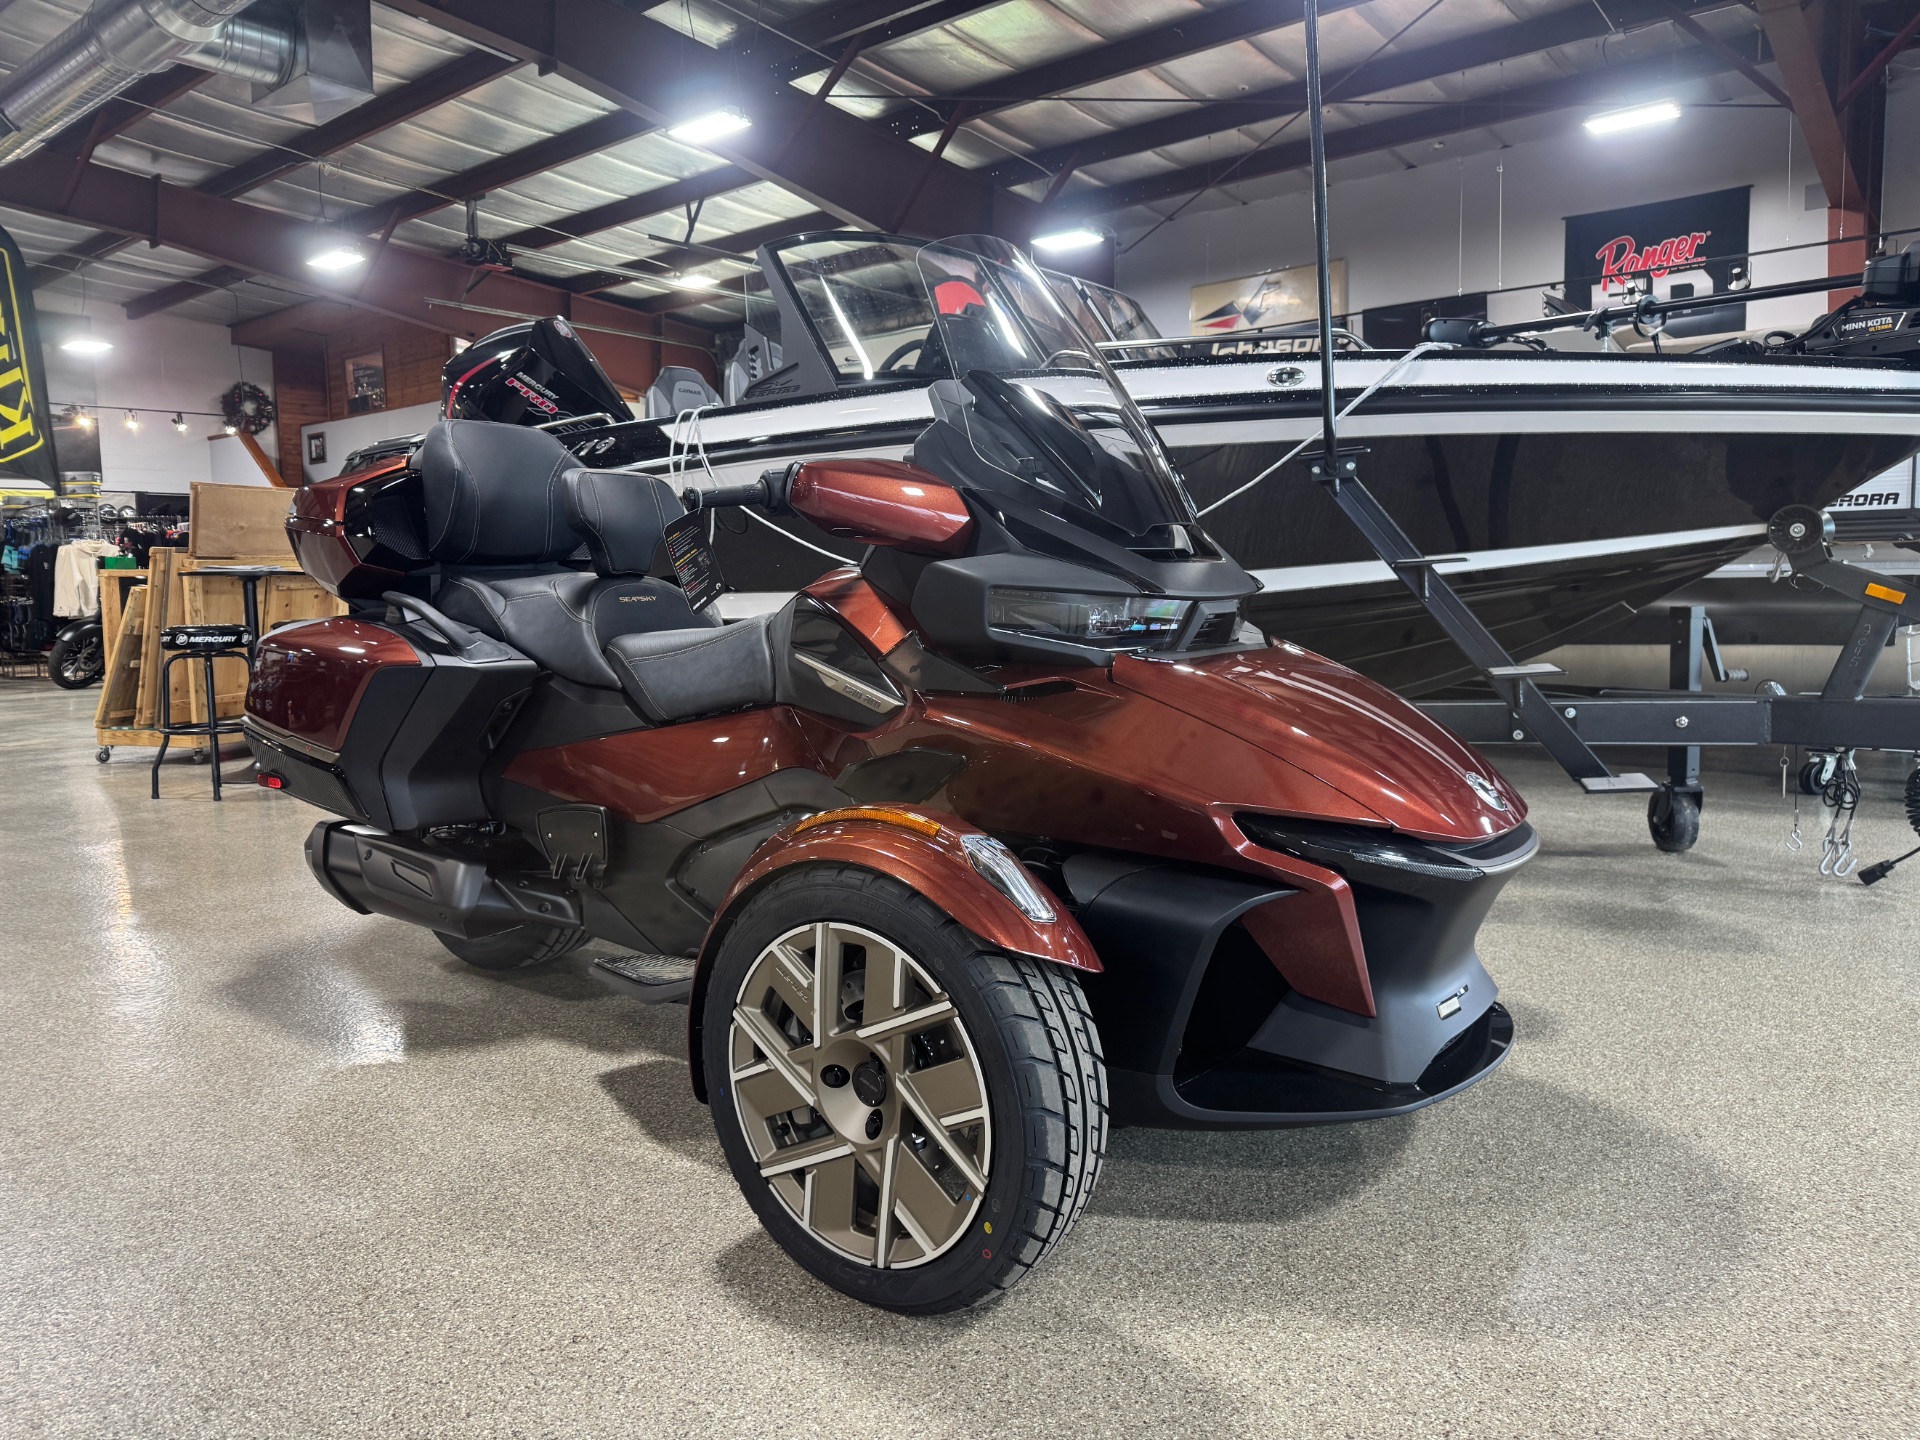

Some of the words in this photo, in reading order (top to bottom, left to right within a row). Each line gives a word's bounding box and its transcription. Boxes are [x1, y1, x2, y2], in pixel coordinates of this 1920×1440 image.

[1595, 232, 1706, 292] Ranger
[1841, 320, 1866, 332] MINN
[1867, 316, 1893, 328] KOTA
[505, 377, 559, 414] PRO
[516, 371, 560, 401] MERCURY
[188, 635, 238, 643] MERCURY
